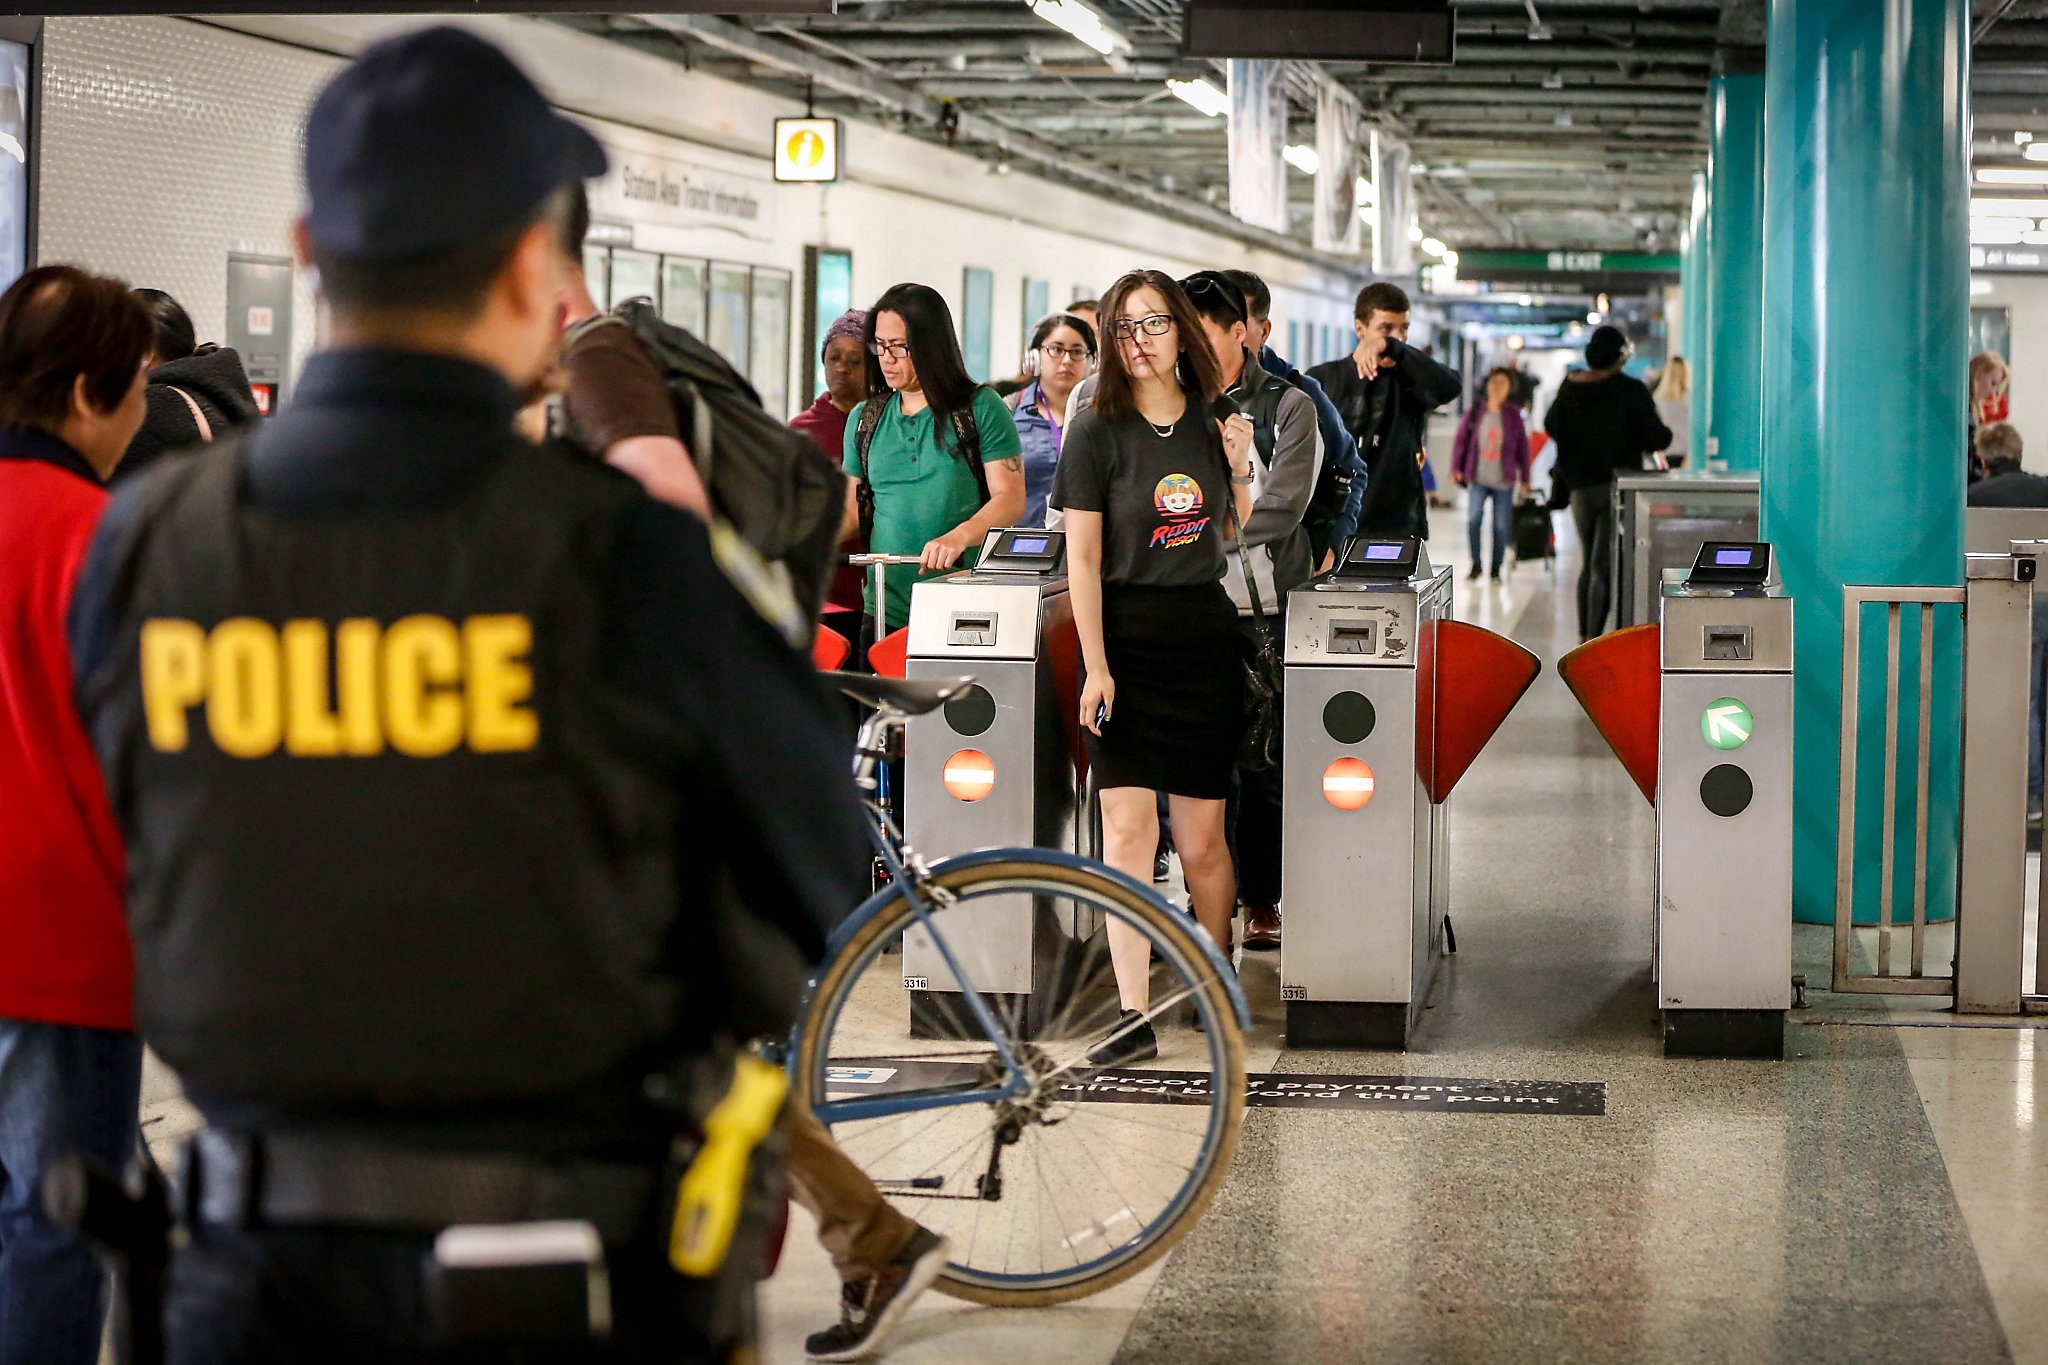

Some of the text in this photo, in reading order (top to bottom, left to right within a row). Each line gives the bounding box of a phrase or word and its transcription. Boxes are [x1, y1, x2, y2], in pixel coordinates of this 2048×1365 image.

[1149, 517, 1210, 548] REDDIT
[1164, 532, 1200, 549] DESIGN
[140, 613, 540, 758] POLICE
[904, 979, 926, 988] 3316
[1282, 989, 1305, 999] 3315
[1095, 1076, 1208, 1086] Proof
[1277, 1082, 1464, 1092] payment
[1060, 1084, 1559, 1104] uired bond this point
